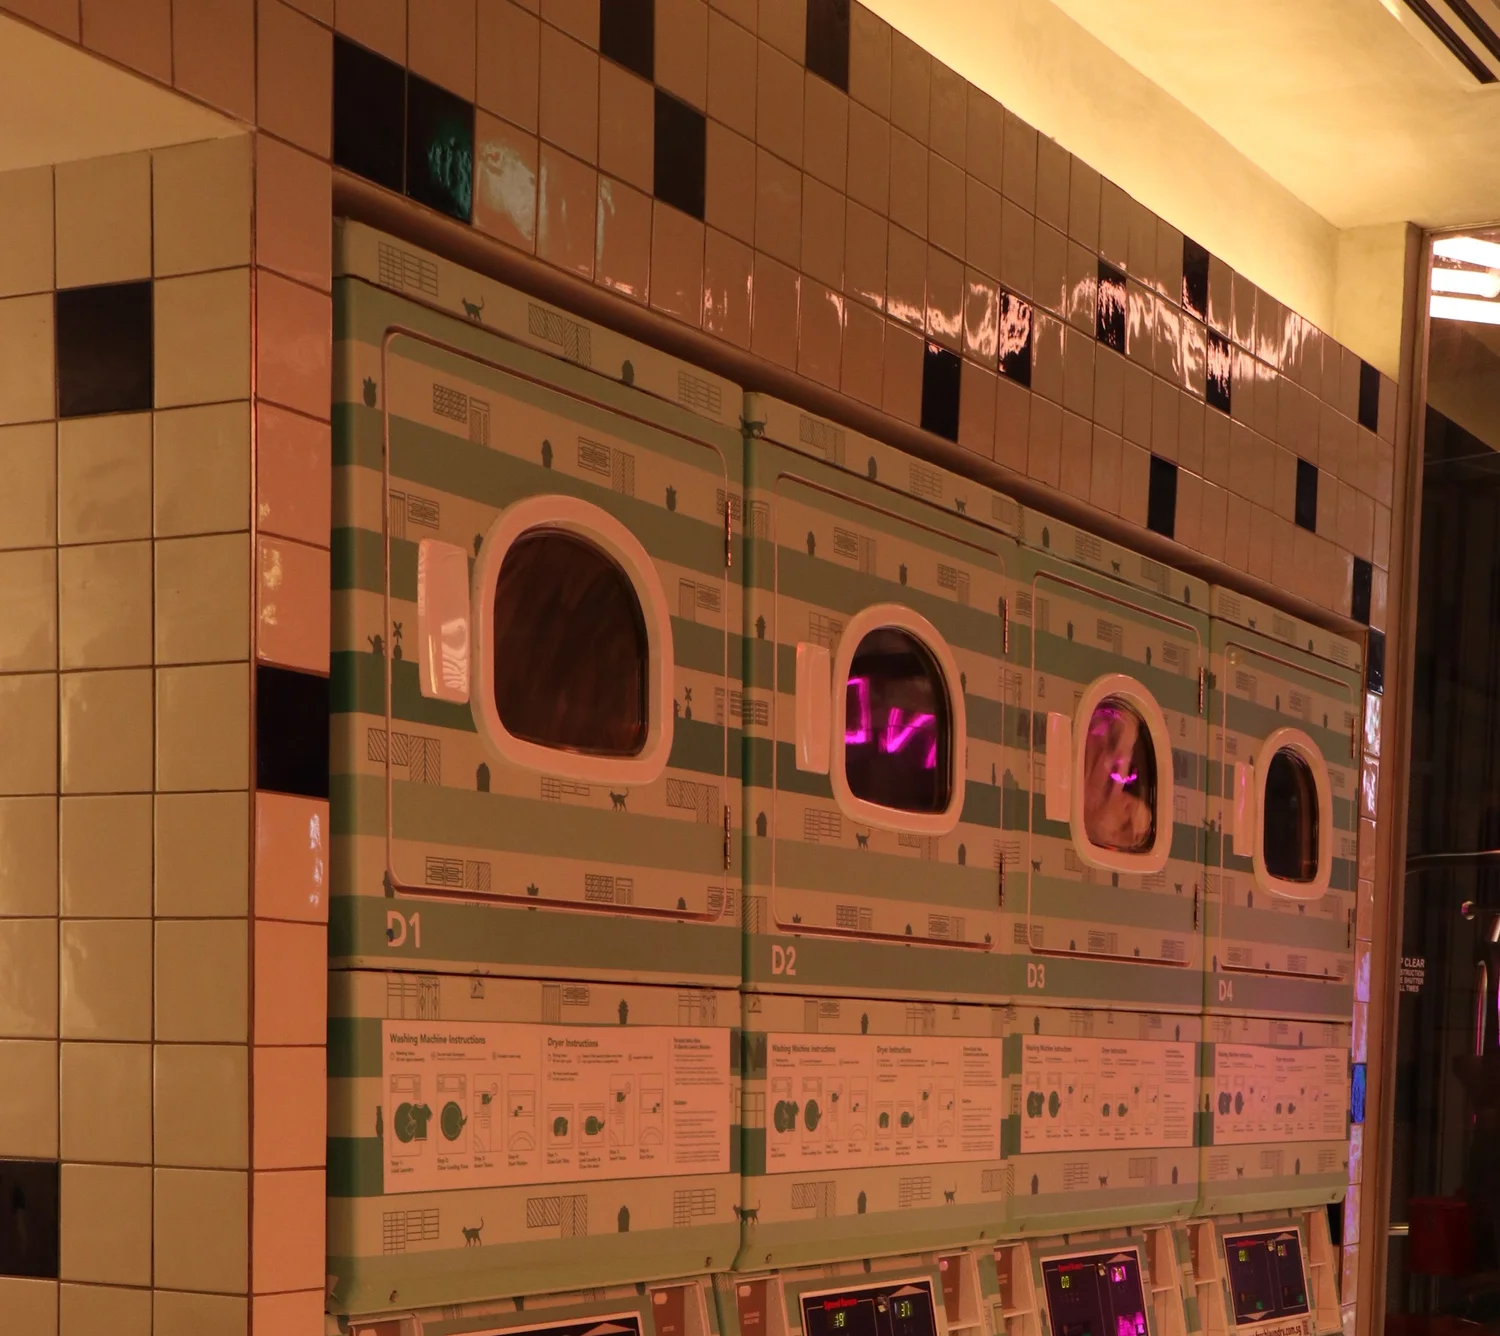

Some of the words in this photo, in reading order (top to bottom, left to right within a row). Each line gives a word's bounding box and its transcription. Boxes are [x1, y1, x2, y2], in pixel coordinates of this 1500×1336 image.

[386, 910, 422, 948] D1
[771, 944, 798, 976] D2
[1404, 957, 1425, 968] CLEAR
[1027, 962, 1046, 989] D3
[1218, 979, 1234, 1002] D4
[389, 1033, 418, 1046] Washing
[419, 1033, 447, 1045] Machine
[448, 1033, 486, 1045] Instructions
[547, 1037, 565, 1049] Dryer
[565, 1038, 599, 1048] Instructions
